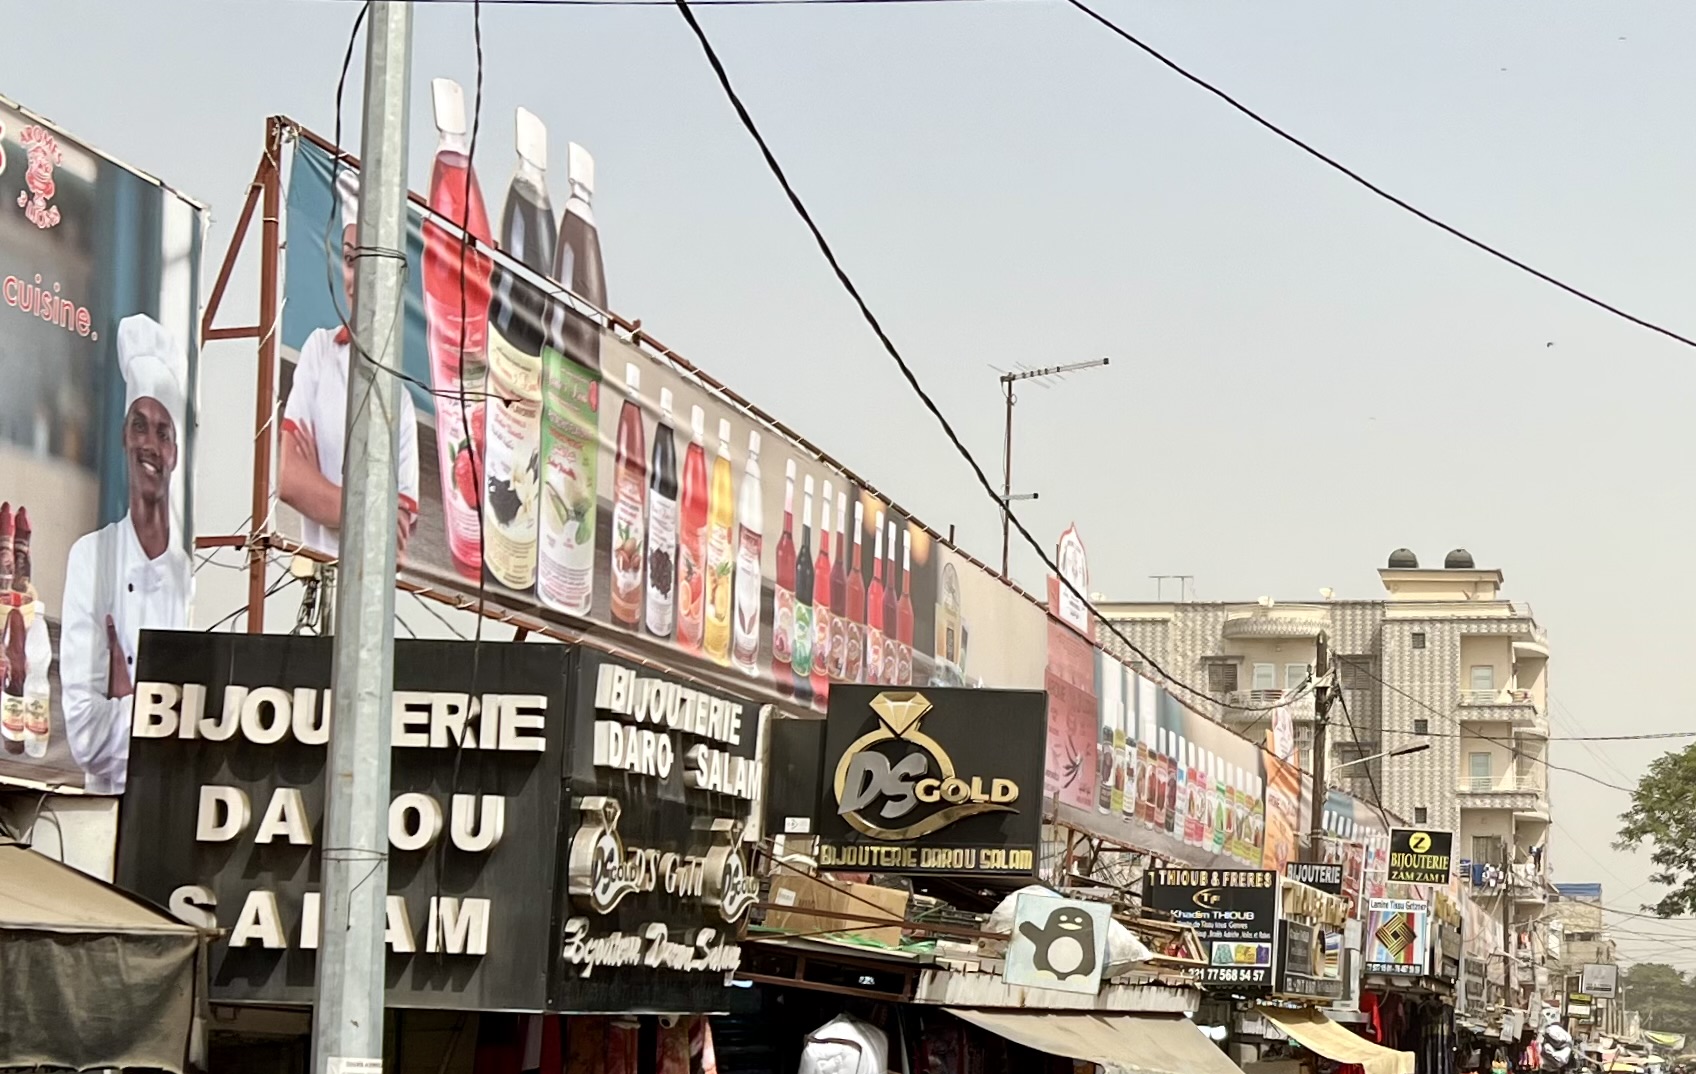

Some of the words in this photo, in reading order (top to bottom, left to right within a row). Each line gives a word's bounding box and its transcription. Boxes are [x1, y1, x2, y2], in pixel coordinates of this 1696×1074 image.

[2, 273, 98, 342] cuisine.
[132, 681, 547, 752] BIJOUERIE
[598, 665, 743, 745] BIJOUTERIE
[690, 743, 762, 800] SALAM
[837, 751, 928, 818] DS
[915, 776, 1019, 804] GOLD
[196, 785, 505, 852] DAOU
[820, 845, 918, 867] BIJOUTERIE
[920, 847, 976, 869] DAROU
[979, 848, 1032, 870] SALAM
[1391, 853, 1449, 871] BIJOUTERIE
[1159, 870, 1209, 887] THIOUB
[1211, 872, 1220, 886] &
[1223, 871, 1272, 888] FRERES
[1287, 864, 1340, 884] BIJOUTERIE
[1391, 871, 1414, 880] ZAM
[1416, 872, 1439, 882] ZAM
[1440, 874, 1445, 883] 1
[1171, 909, 1210, 920] Khadim
[1213, 911, 1254, 920] THIOUB
[1253, 970, 1264, 982] 57
